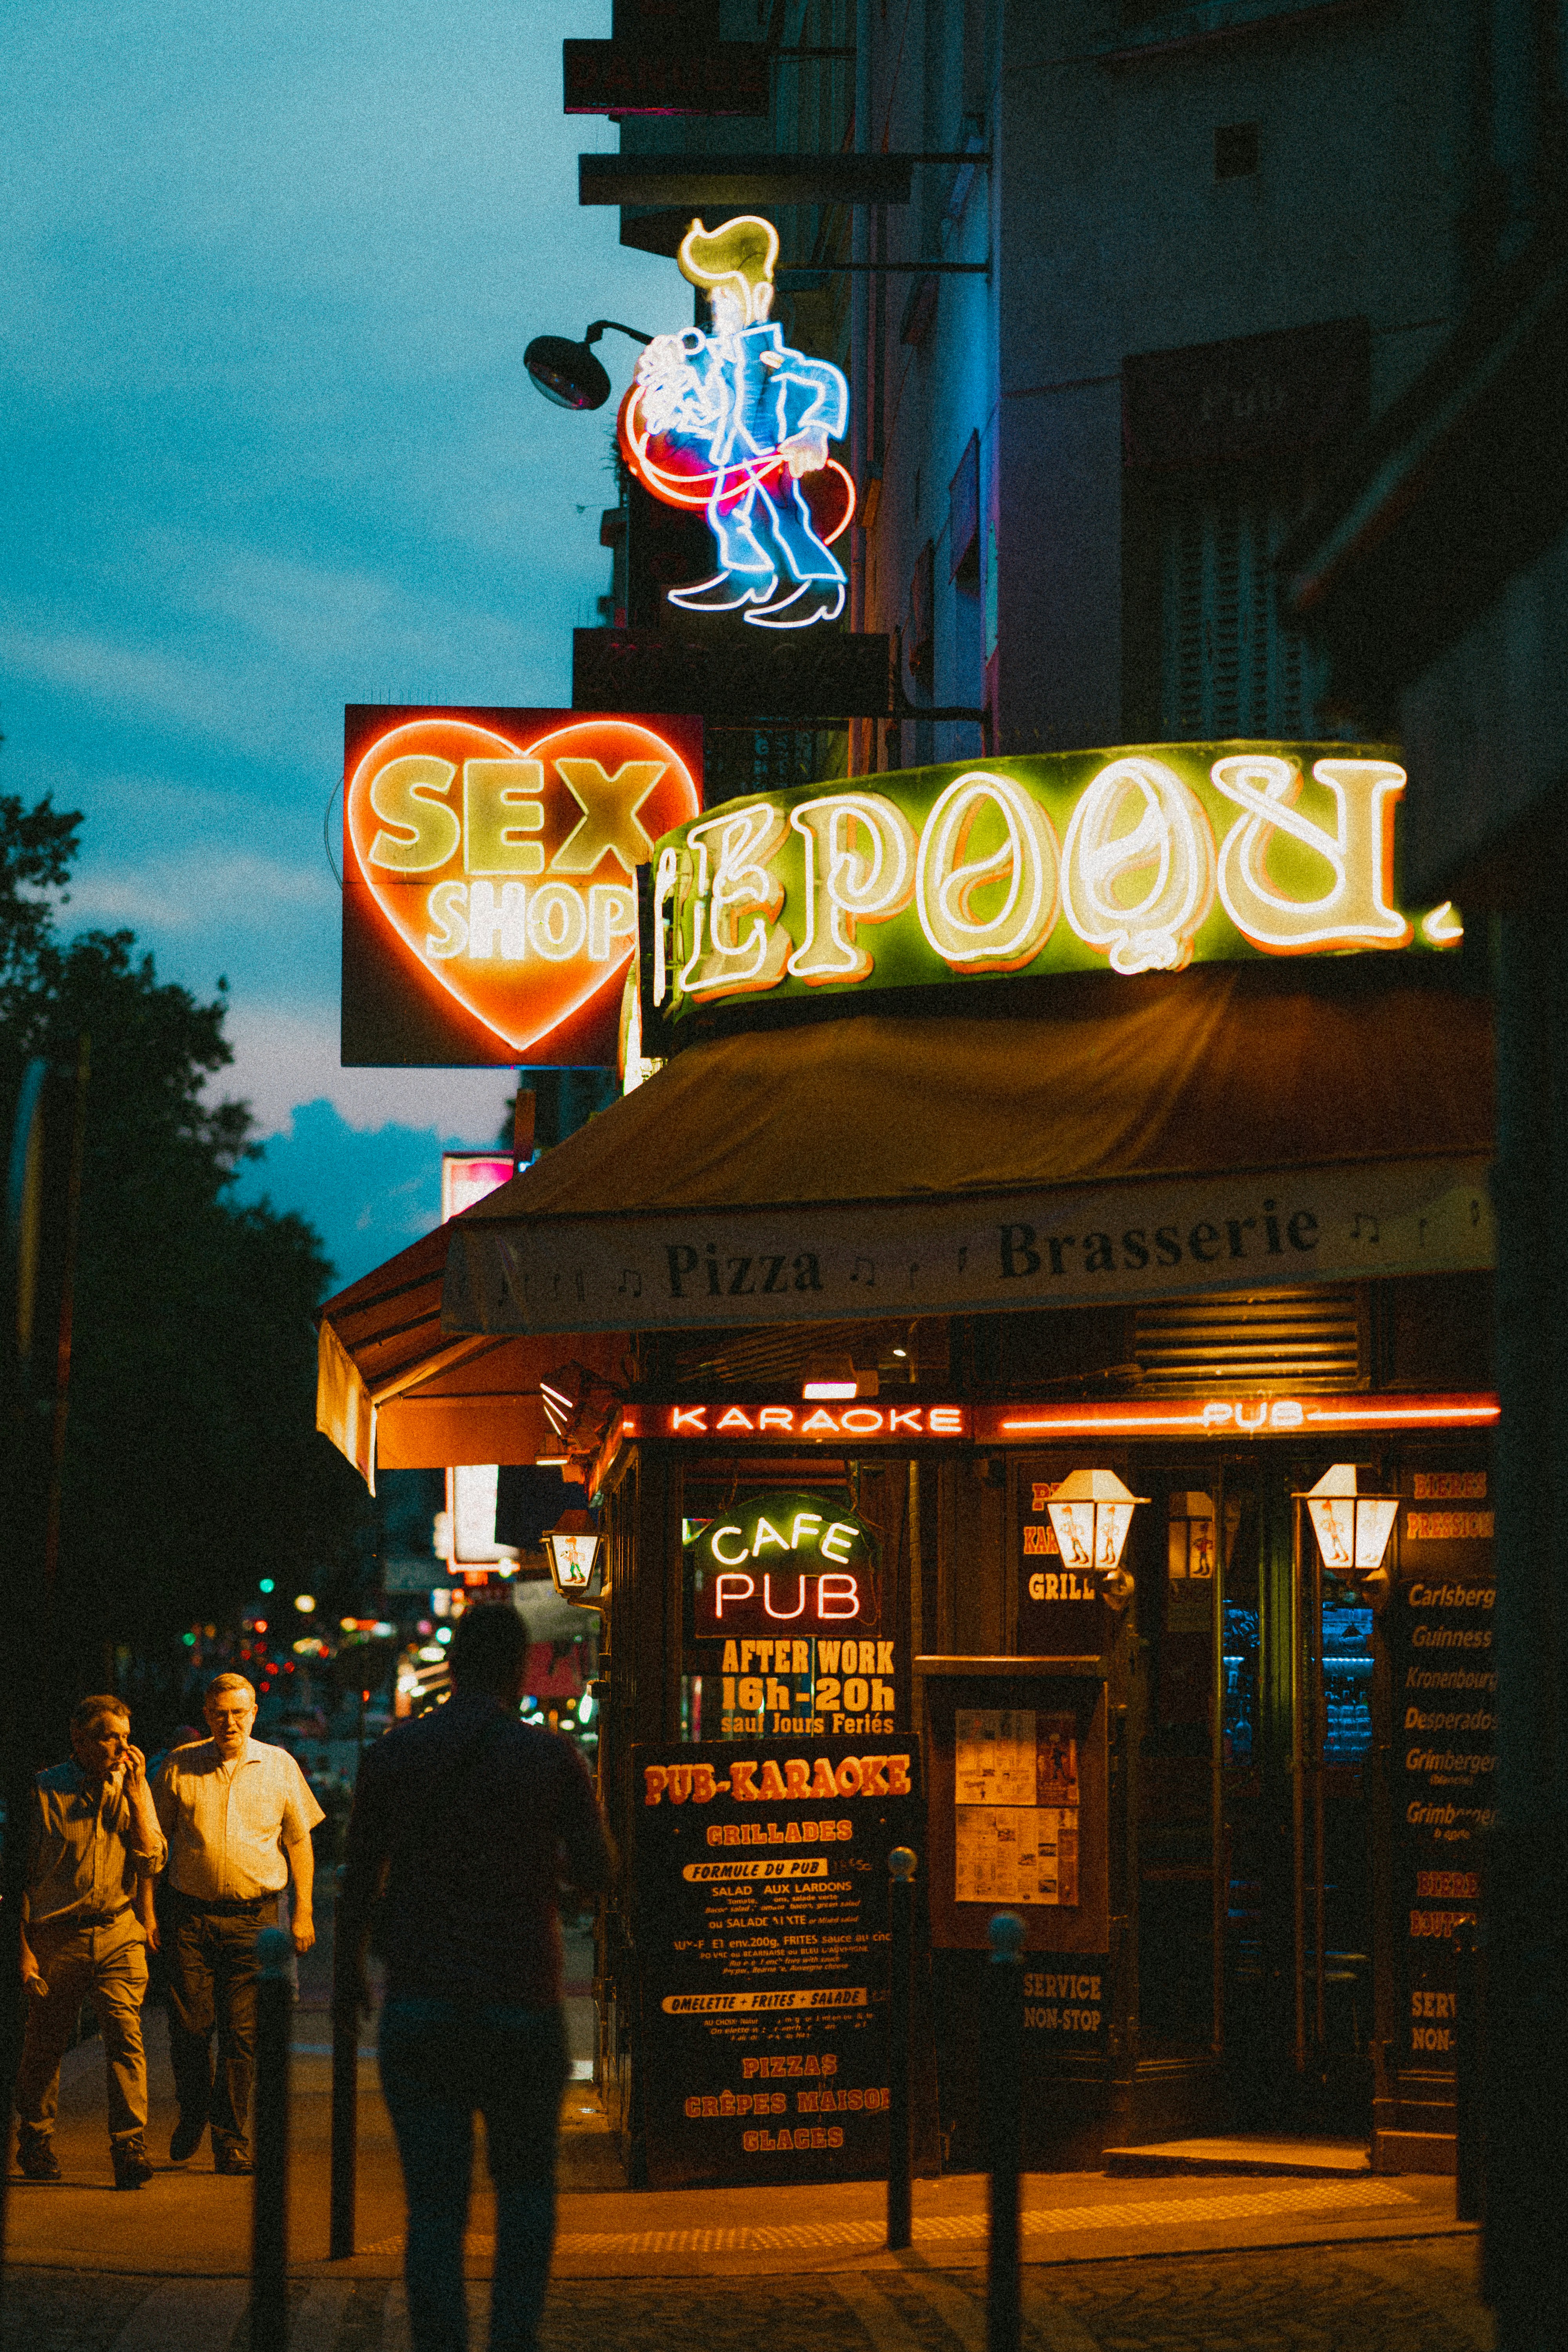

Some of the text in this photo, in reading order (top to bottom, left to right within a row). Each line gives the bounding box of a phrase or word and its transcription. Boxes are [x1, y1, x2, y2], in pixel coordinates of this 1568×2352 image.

[368, 755, 670, 875] SEX
[425, 880, 638, 962] SHOP
[666, 1199, 1319, 1298] Pizza Brasserie
[672, 1406, 963, 1433] KARAOKE
[1202, 1400, 1305, 1430] PUB
[1414, 1472, 1486, 1499] BIERES
[711, 1513, 859, 1565] CAFE
[716, 1573, 860, 1619] PUB
[1029, 1573, 1096, 1600] GRILL
[1408, 1584, 1496, 1610] Carlsberg
[1412, 1625, 1493, 1650] Guinness
[722, 1640, 895, 1675] AFTER WORK
[721, 1713, 766, 1733] sauf
[772, 1714, 824, 1734] Jours
[643, 1754, 912, 1806] PUB-KARAOKE
[706, 1819, 853, 1846] GRILLADES
[693, 1864, 759, 1879] FORMULE
[765, 1863, 784, 1876] DU
[791, 1861, 820, 1874] PUB
[764, 1884, 790, 1895] AUX
[795, 1881, 853, 1894] LARDONS
[784, 1935, 818, 1945] FRITES
[822, 1935, 852, 1944] sauce
[1024, 1973, 1101, 2001] SERVICE
[671, 1996, 736, 2011] OMELETTE
[751, 1993, 795, 2008] FRITES
[810, 1991, 860, 2005] SALADE
[1024, 2006, 1101, 2032] NON-STOP
[742, 2054, 838, 2078] PIZZAS
[685, 2089, 787, 2118] CRÊPES
[742, 2127, 844, 2152] GLACES
